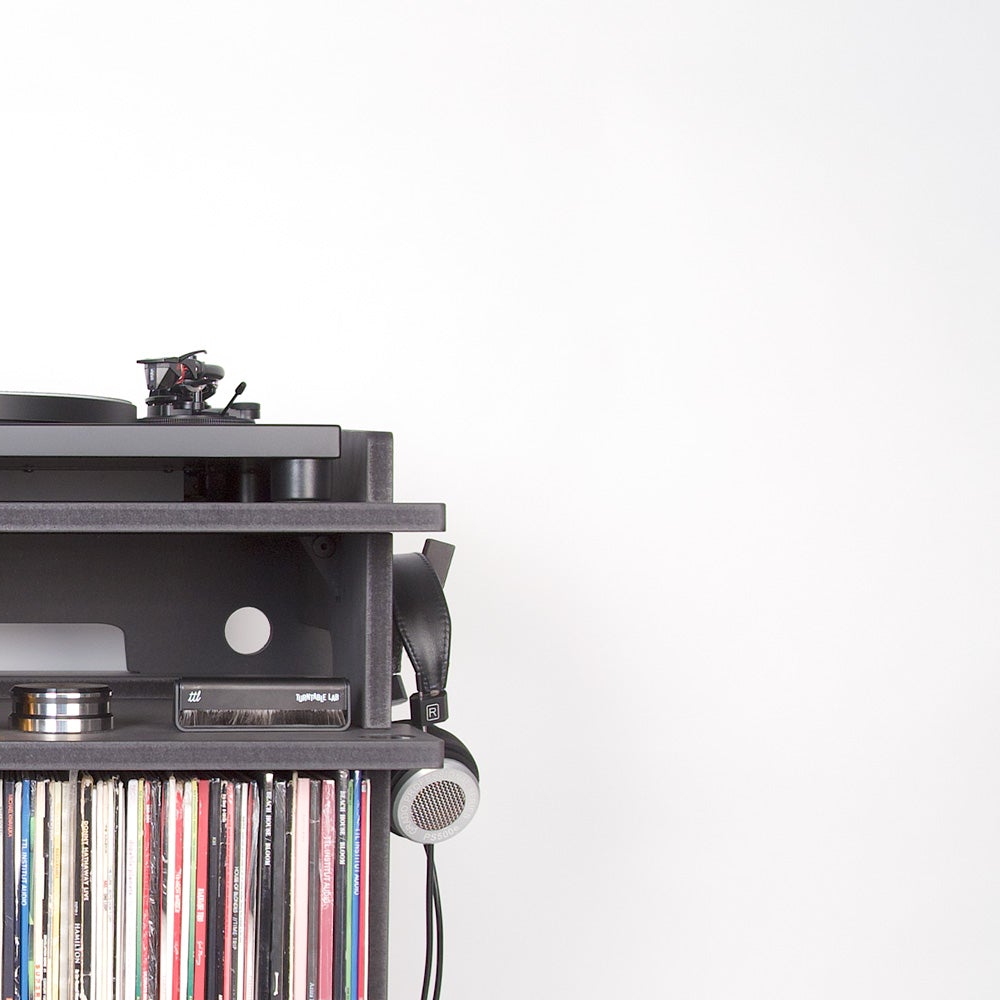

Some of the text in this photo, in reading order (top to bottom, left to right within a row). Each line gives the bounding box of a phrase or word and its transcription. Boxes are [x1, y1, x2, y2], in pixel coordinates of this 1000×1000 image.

[295, 692, 340, 703] TURNTABLE LAB
[323, 837, 332, 904] TTL INSTITUT AUDIO
